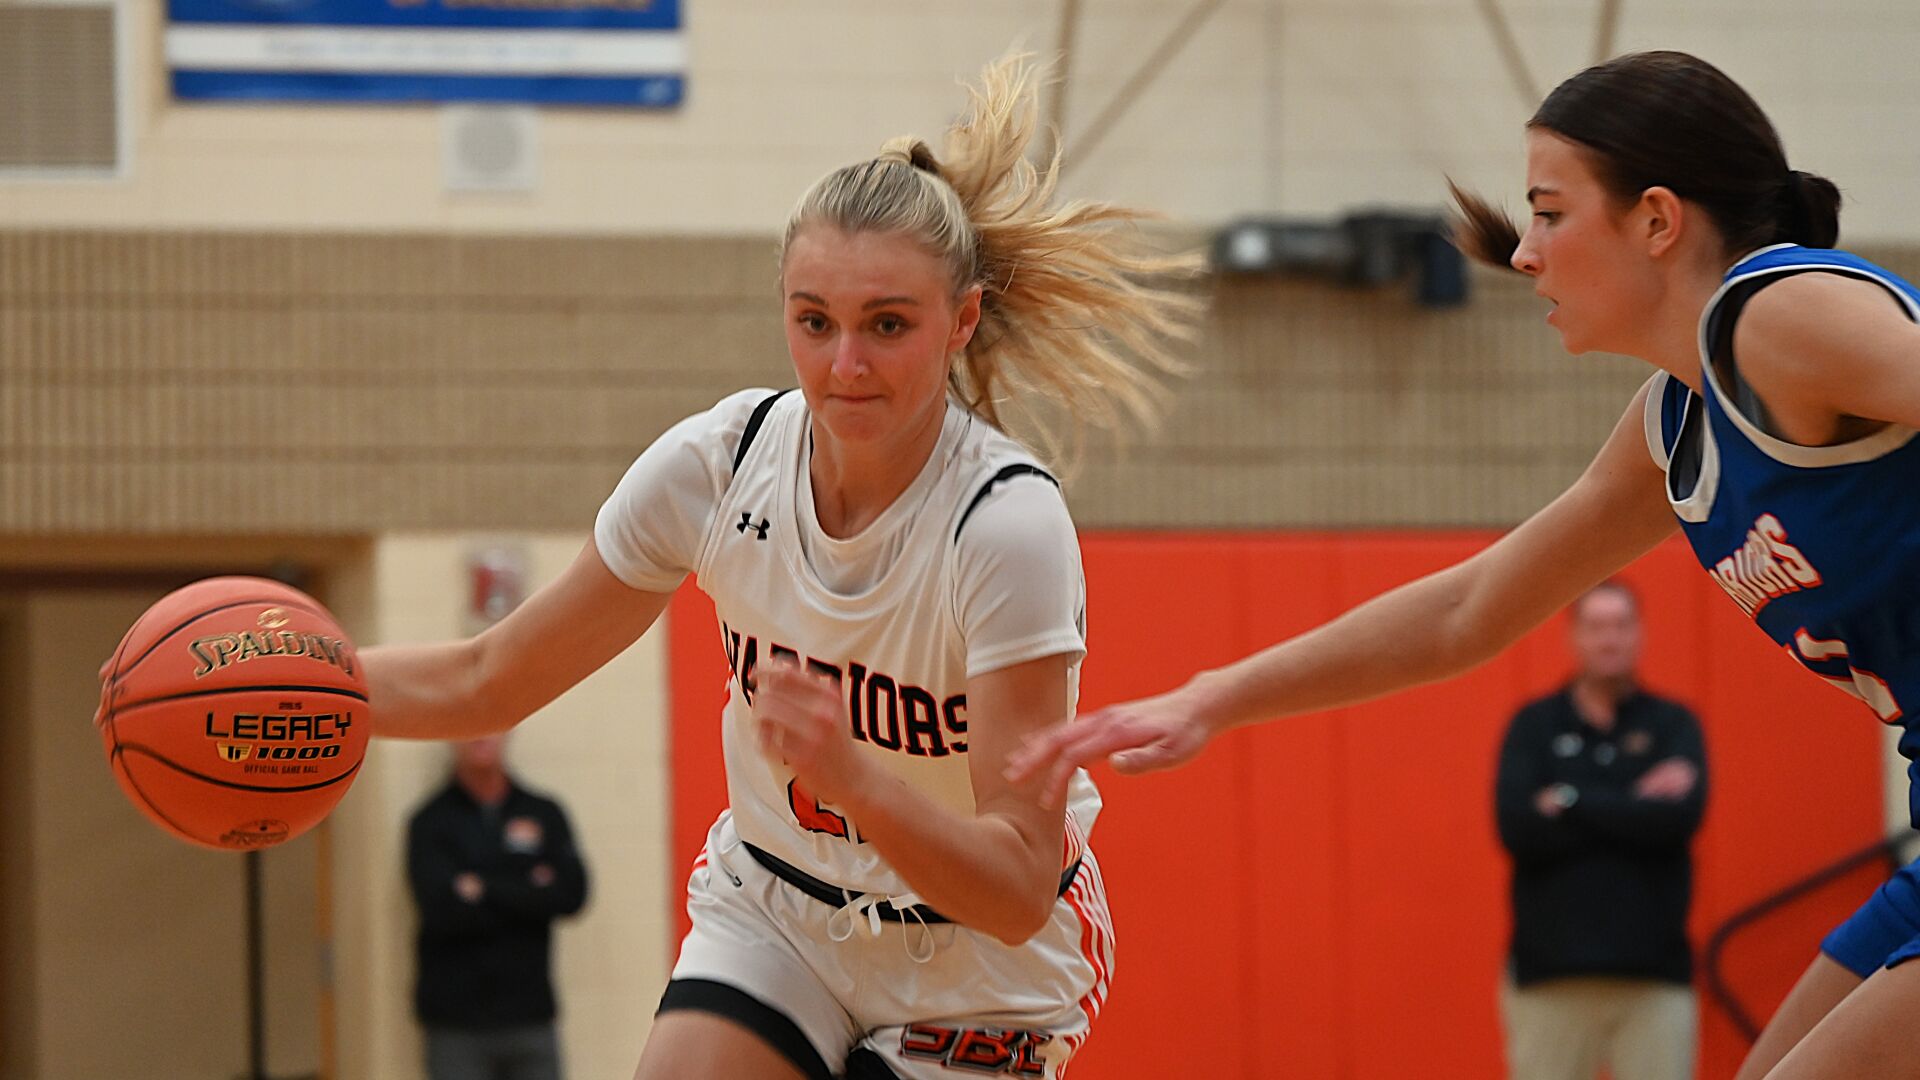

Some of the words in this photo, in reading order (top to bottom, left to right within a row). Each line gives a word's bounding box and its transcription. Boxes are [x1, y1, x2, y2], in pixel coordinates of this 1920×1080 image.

[206, 711, 352, 741] LEGACY
[255, 744, 342, 760] 1000
[244, 764, 278, 774] OFFICIAL
[282, 765, 300, 774] GAME
[303, 765, 318, 773] BALL
